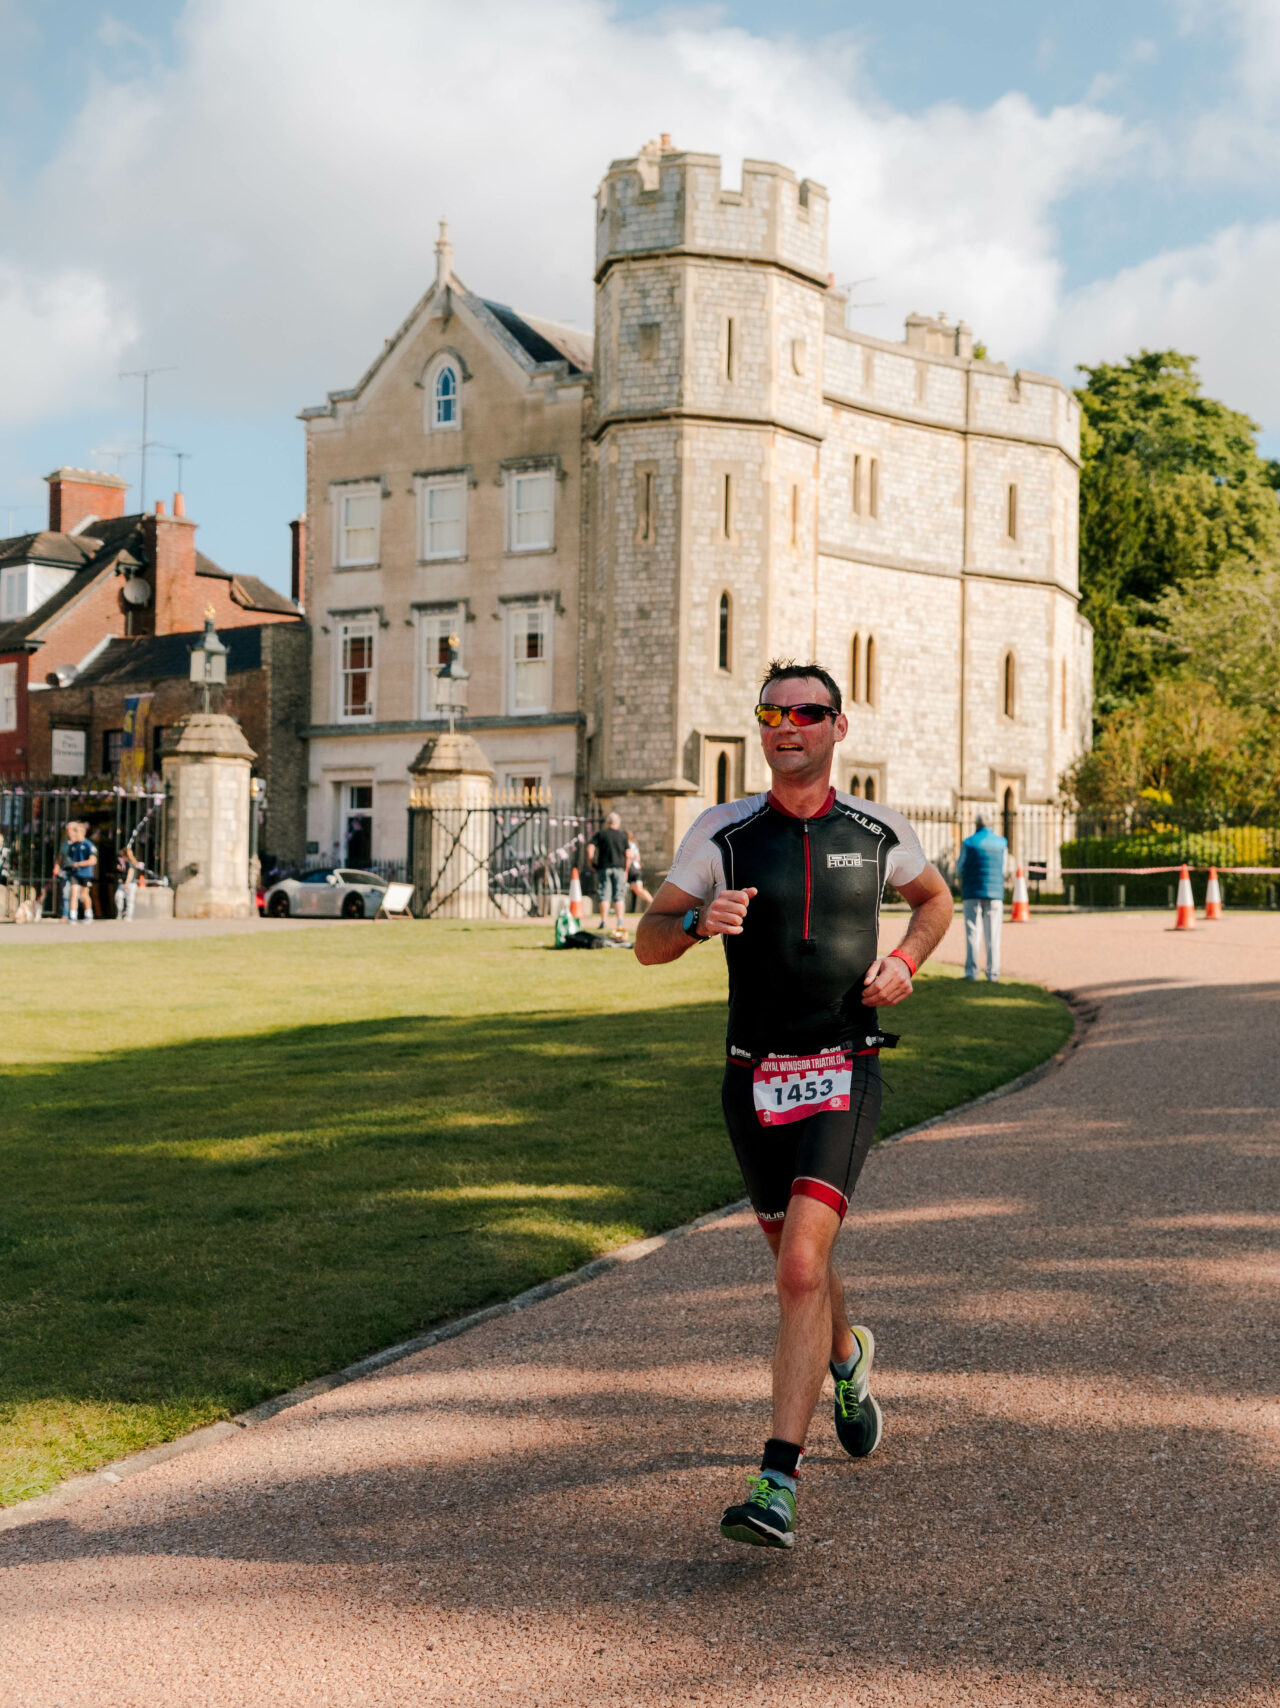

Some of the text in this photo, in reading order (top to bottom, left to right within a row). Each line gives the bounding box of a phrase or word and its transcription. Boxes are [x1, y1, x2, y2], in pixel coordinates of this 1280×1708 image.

[845, 810, 883, 835] HUUB
[761, 1053, 846, 1072] ROYAL WINDSOR TRIATHLON
[774, 1078, 834, 1106] 1453
